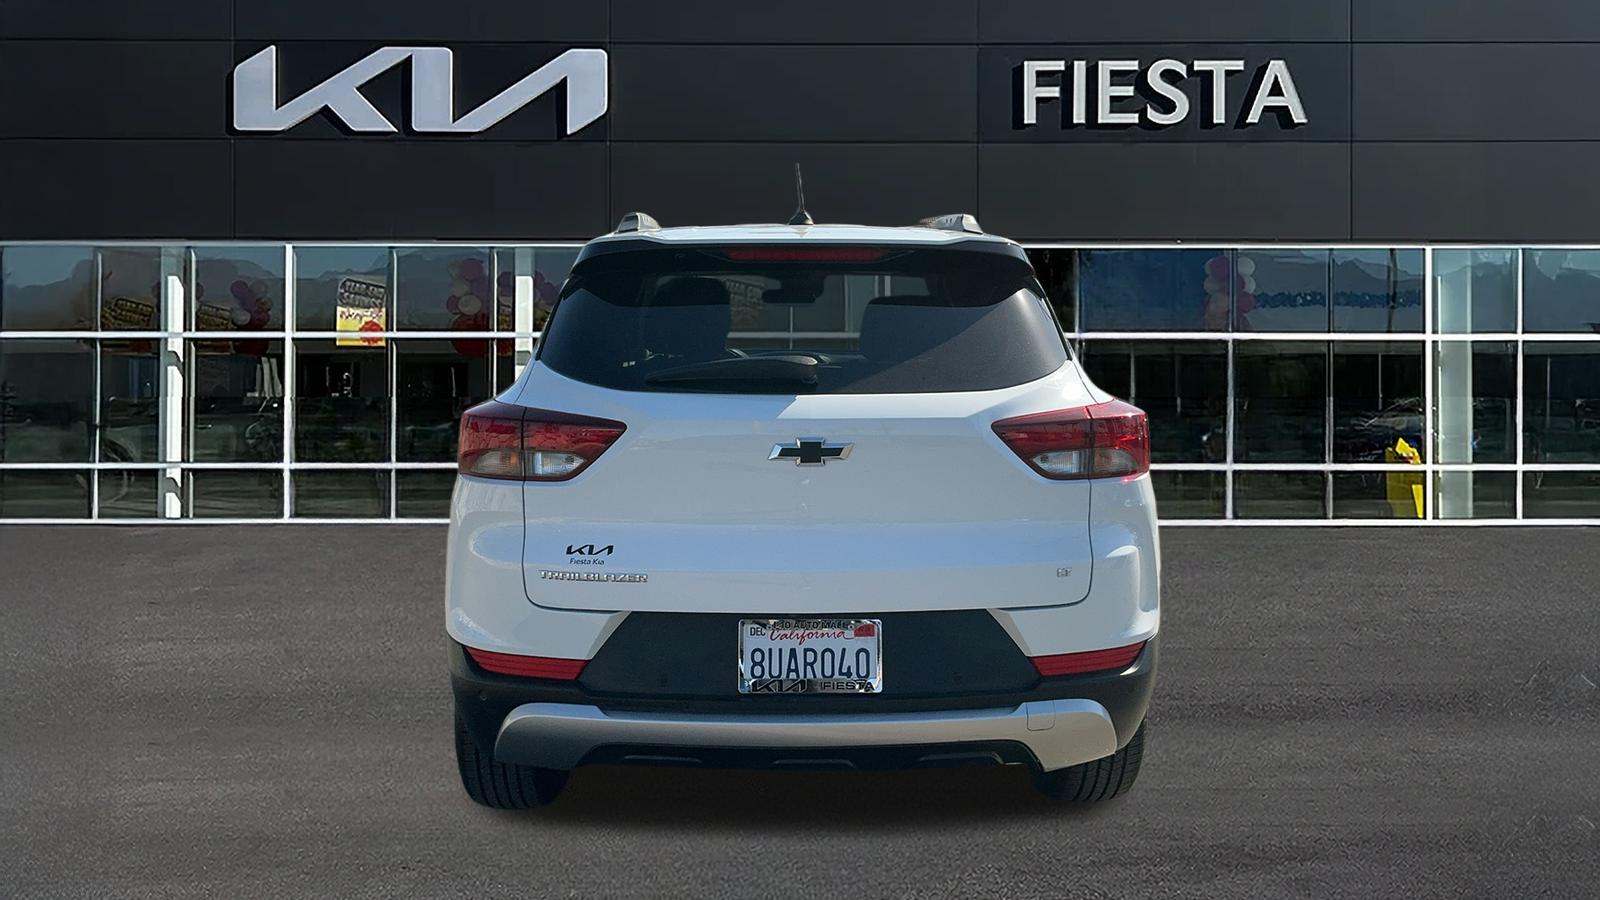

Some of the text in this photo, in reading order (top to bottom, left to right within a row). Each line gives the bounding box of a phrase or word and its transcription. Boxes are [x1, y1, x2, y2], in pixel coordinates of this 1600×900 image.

[234, 45, 608, 135] KIA
[1024, 59, 1308, 125] FIESTA
[566, 544, 614, 556] KIA
[539, 570, 648, 583] TRAILBLAZER
[750, 627, 766, 636] DEC
[821, 620, 848, 630] MALL
[769, 629, 854, 645] California
[750, 648, 870, 679] 8UAR040
[821, 681, 874, 690] FIESTA
